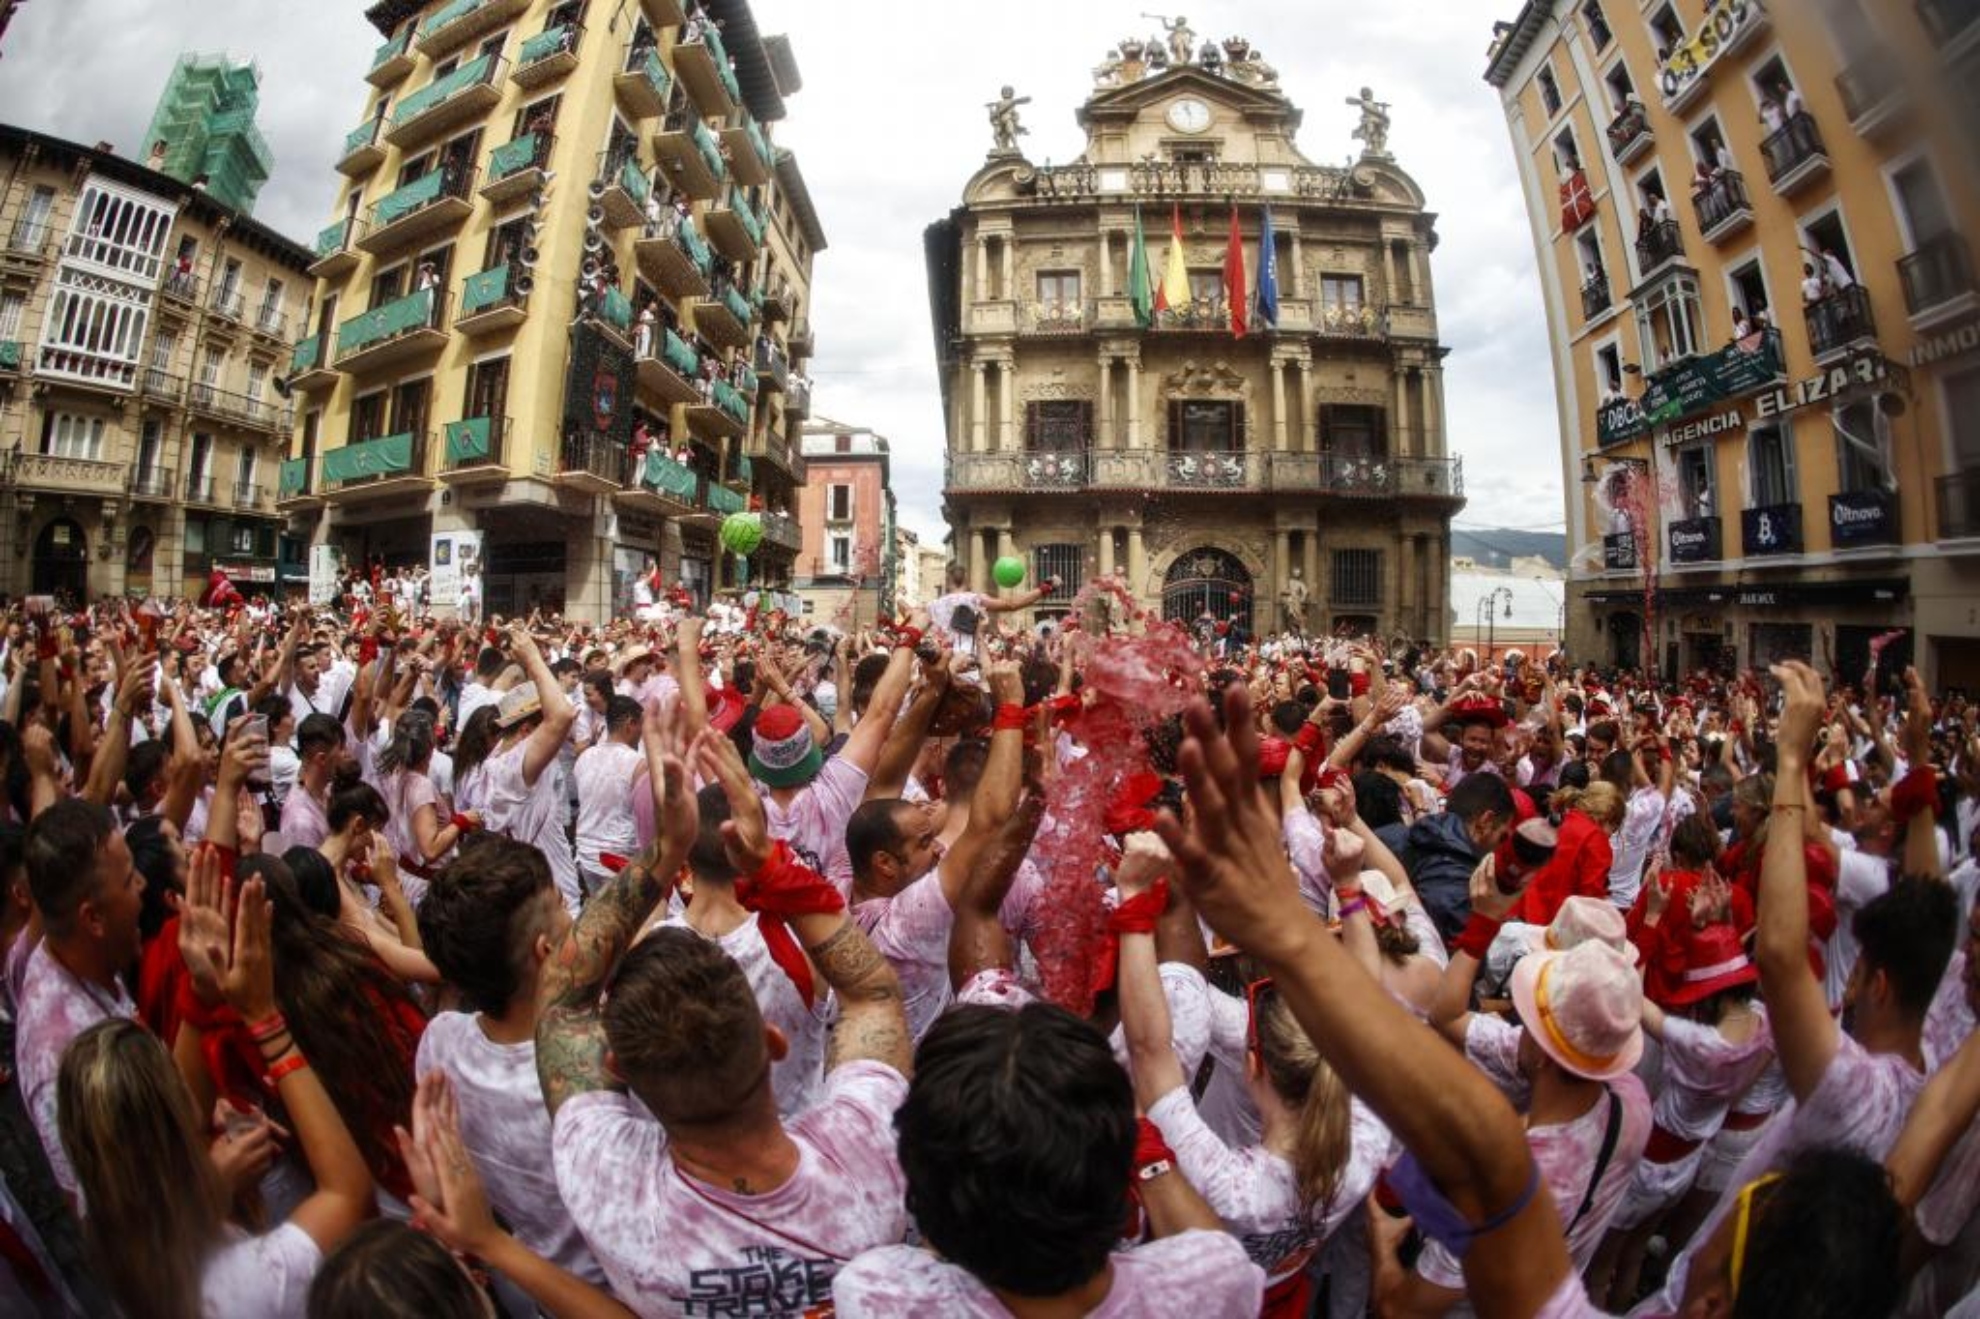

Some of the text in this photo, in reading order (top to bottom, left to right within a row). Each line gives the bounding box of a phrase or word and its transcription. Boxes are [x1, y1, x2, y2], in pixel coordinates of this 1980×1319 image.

[1906, 321, 1980, 367] INMO
[1661, 410, 1741, 447] AGENCIA
[740, 1246, 787, 1264] THE
